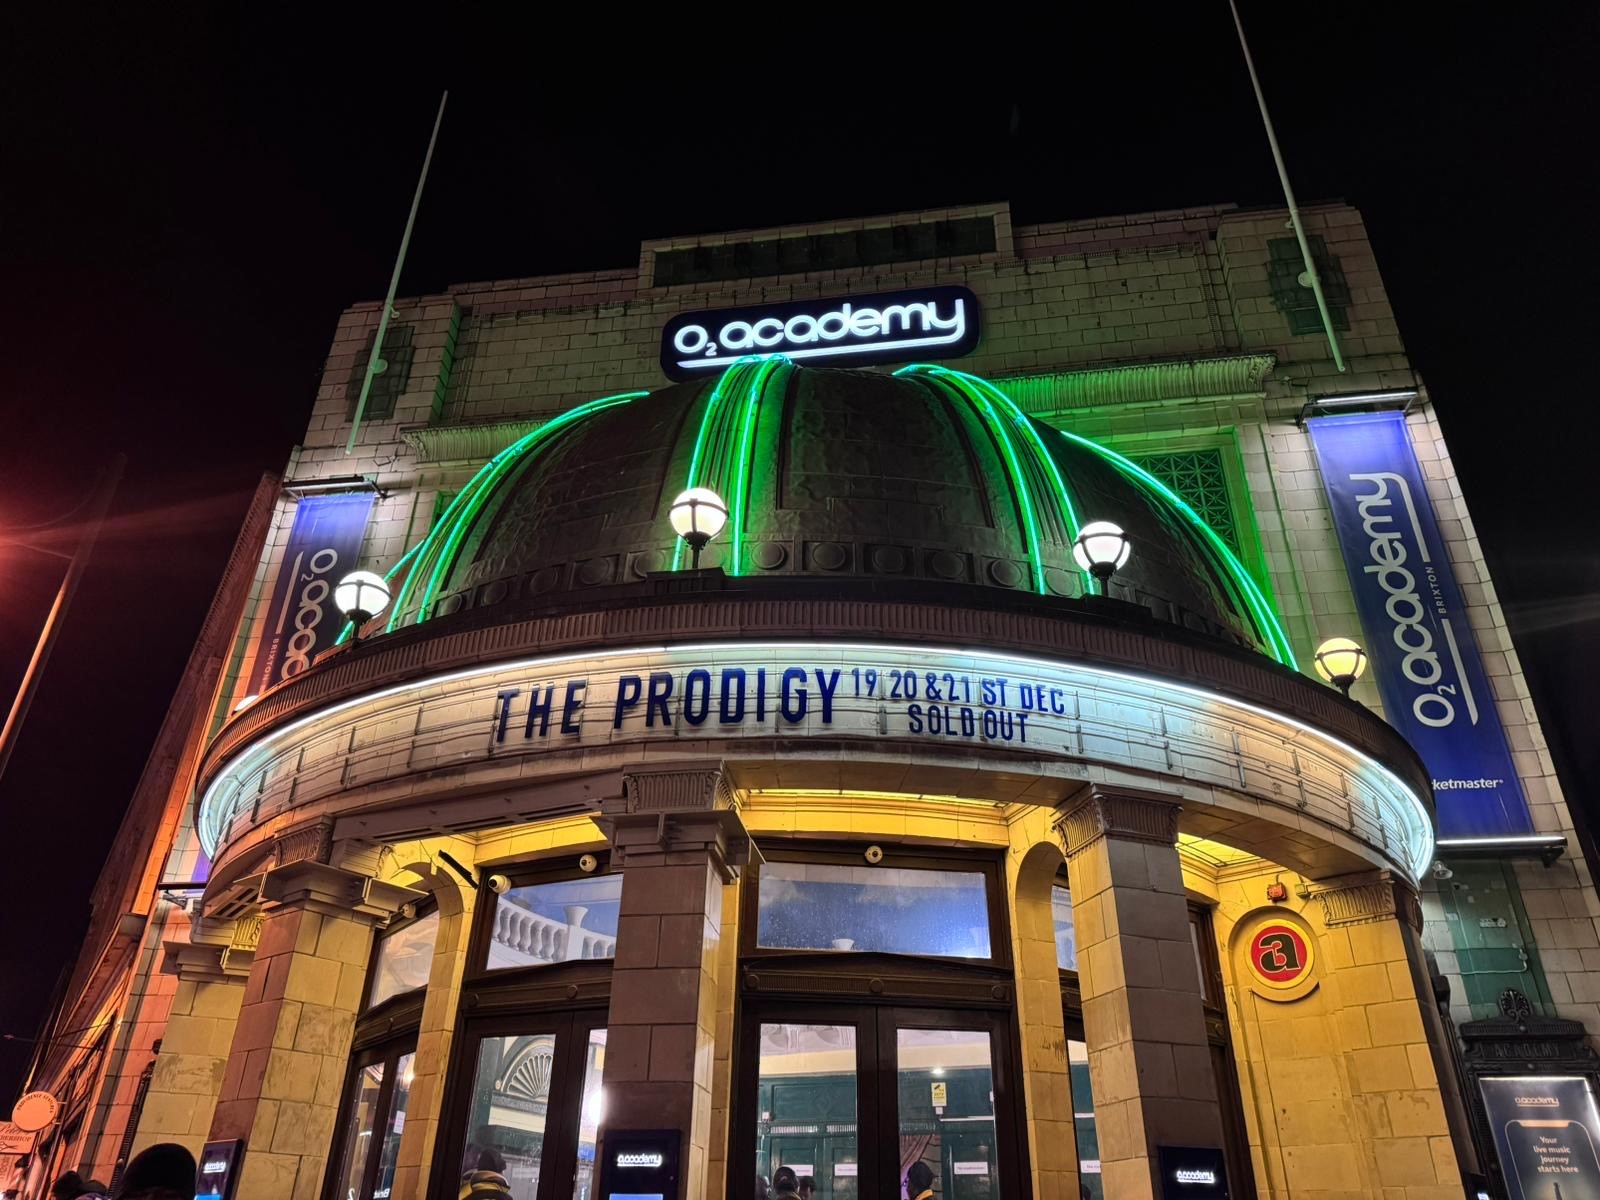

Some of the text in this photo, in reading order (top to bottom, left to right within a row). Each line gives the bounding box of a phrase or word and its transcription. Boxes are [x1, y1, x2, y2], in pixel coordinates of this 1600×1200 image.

[719, 298, 966, 350] academy
[1350, 473, 1442, 686] academy
[1425, 567, 1447, 614] BRIXTON
[262, 637, 280, 679] BRIXTON
[497, 667, 841, 743] THE PRODIGY
[851, 667, 877, 697] 19
[981, 678, 1008, 707] ST
[1019, 682, 1065, 715] DEC
[907, 704, 1029, 743] SOLD OUT
[1431, 778, 1499, 790] ketmaster
[1539, 1136, 1557, 1144] Your
[1540, 1156, 1569, 1164] journey
